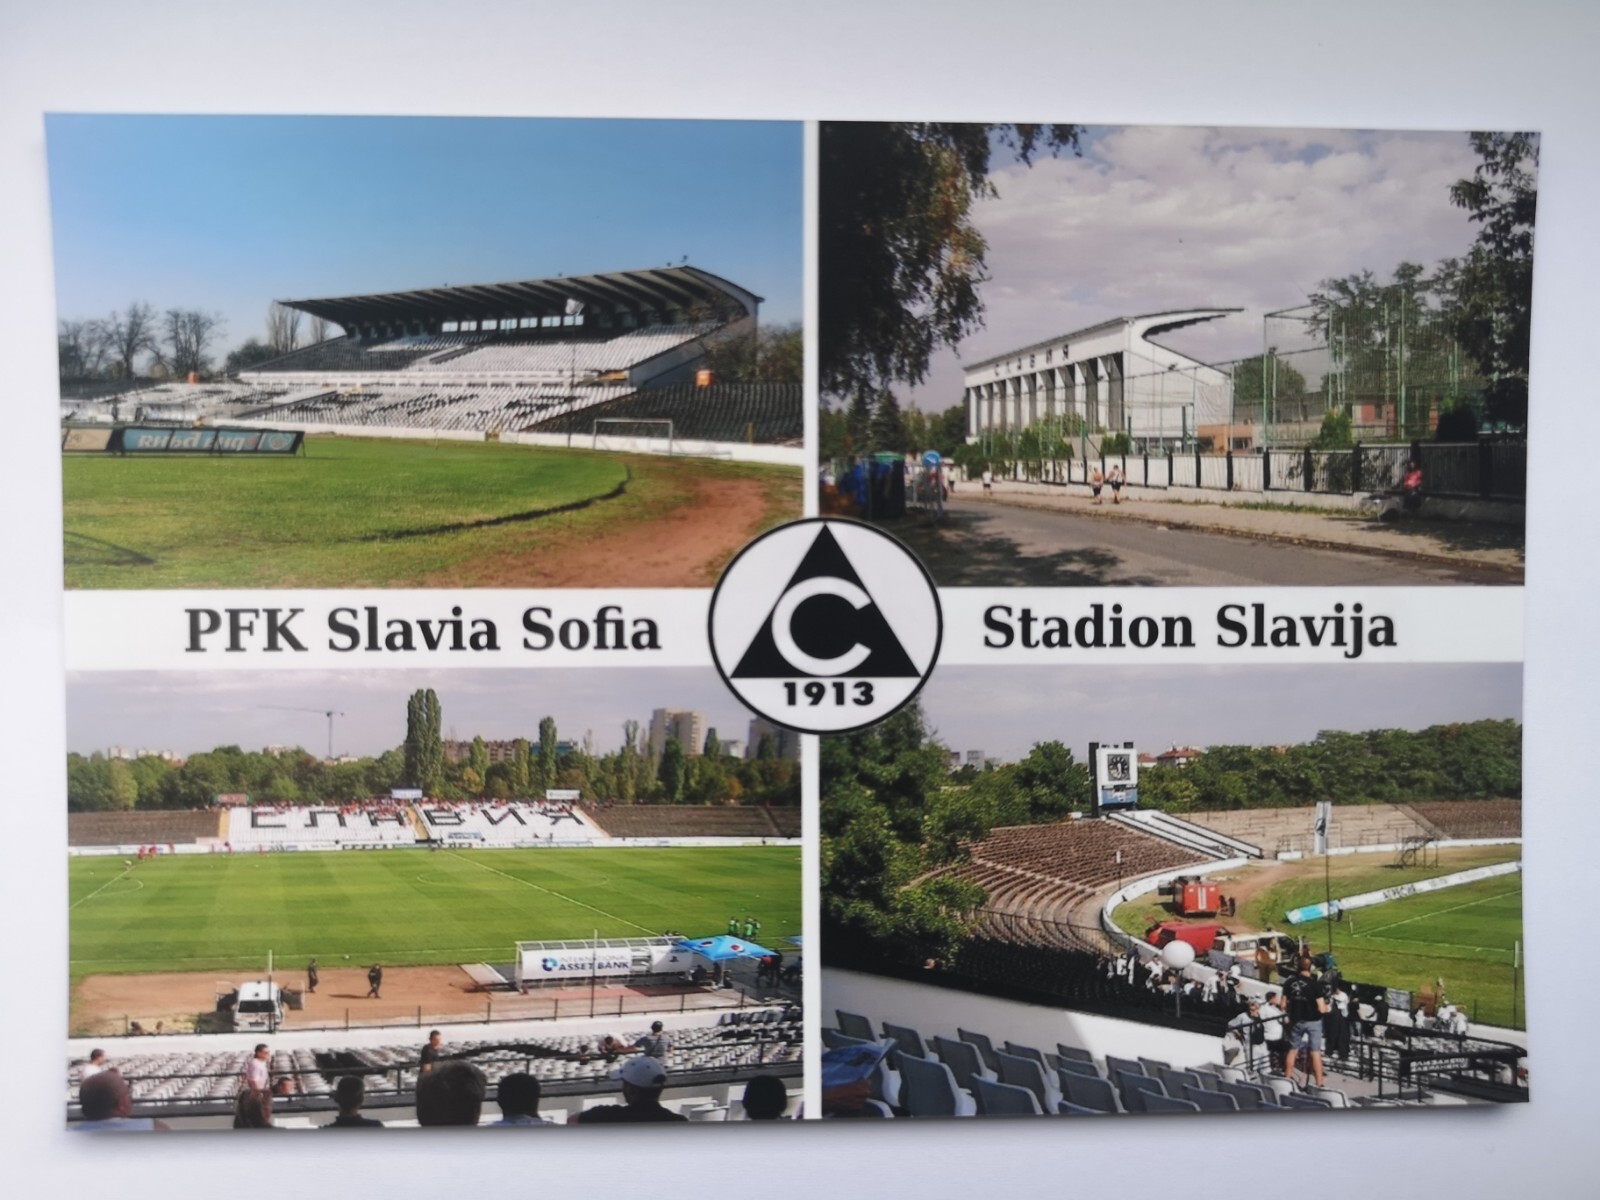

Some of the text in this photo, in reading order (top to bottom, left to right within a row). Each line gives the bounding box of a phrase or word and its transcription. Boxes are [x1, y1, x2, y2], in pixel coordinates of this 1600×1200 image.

[185, 606, 661, 652] PFK Slavia Sofia
[984, 603, 1397, 658] Stadion Slavija
[784, 682, 874, 706] 1913
[558, 961, 630, 971] ASSET BANK
